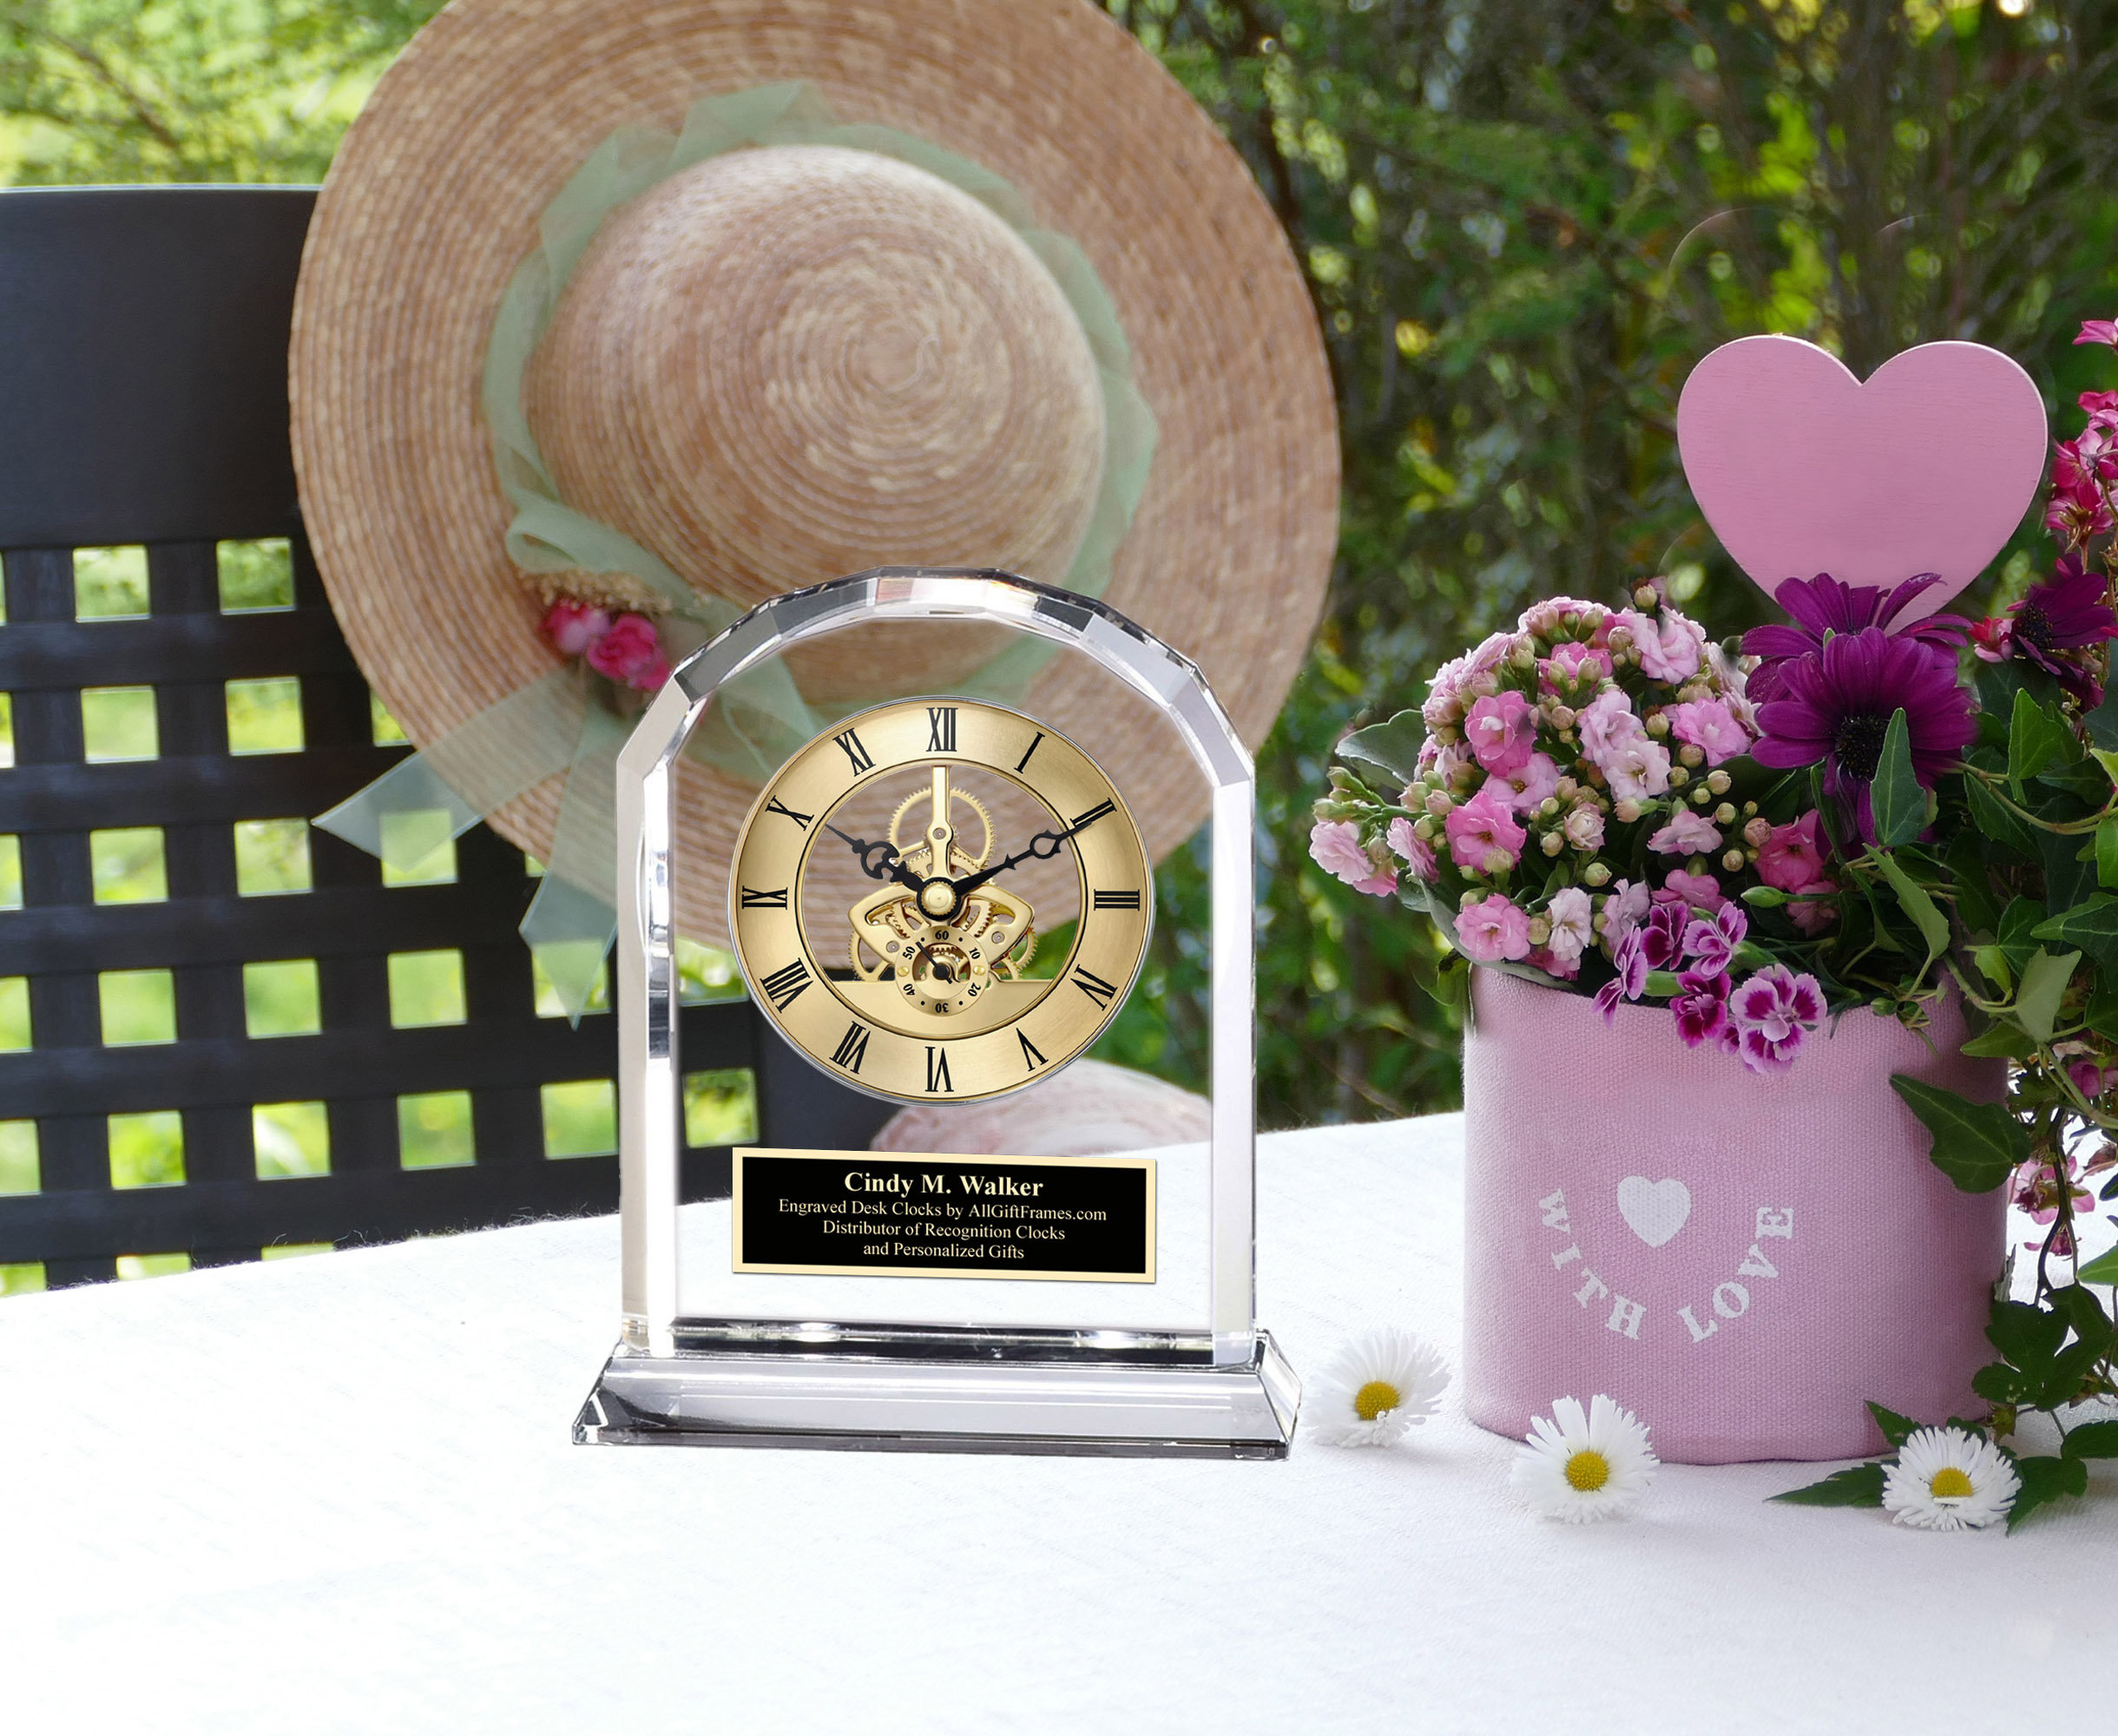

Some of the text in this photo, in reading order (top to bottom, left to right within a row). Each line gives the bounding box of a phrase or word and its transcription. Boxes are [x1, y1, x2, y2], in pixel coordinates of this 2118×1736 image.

[926, 707, 958, 752] XII
[832, 727, 877, 778] XI
[1014, 732, 1046, 774] I
[765, 794, 815, 831] X
[1069, 797, 1118, 827] II
[741, 884, 788, 911] IX
[1093, 889, 1141, 911] III
[935, 930, 949, 940] 60
[902, 946, 916, 960] 50
[969, 947, 981, 959] 10
[760, 957, 814, 1014] VIII
[903, 983, 916, 996] 40
[967, 983, 982, 997] 20
[1069, 964, 1119, 1011] IV
[935, 1003, 949, 1013] 30
[829, 1021, 872, 1075] VII
[1016, 1027, 1049, 1073] V
[924, 1047, 955, 1093] VI
[844, 1172, 1044, 1198] Cindy M. Walker
[779, 1199, 1107, 1221] Engraved Desk Clocks by AllGiftFrames.com
[823, 1220, 1066, 1241] Distributor of Recognition Clocks
[863, 1242, 1025, 1259] and Personalized Gifts
[1538, 1187, 1794, 1343] WITH LOVE
